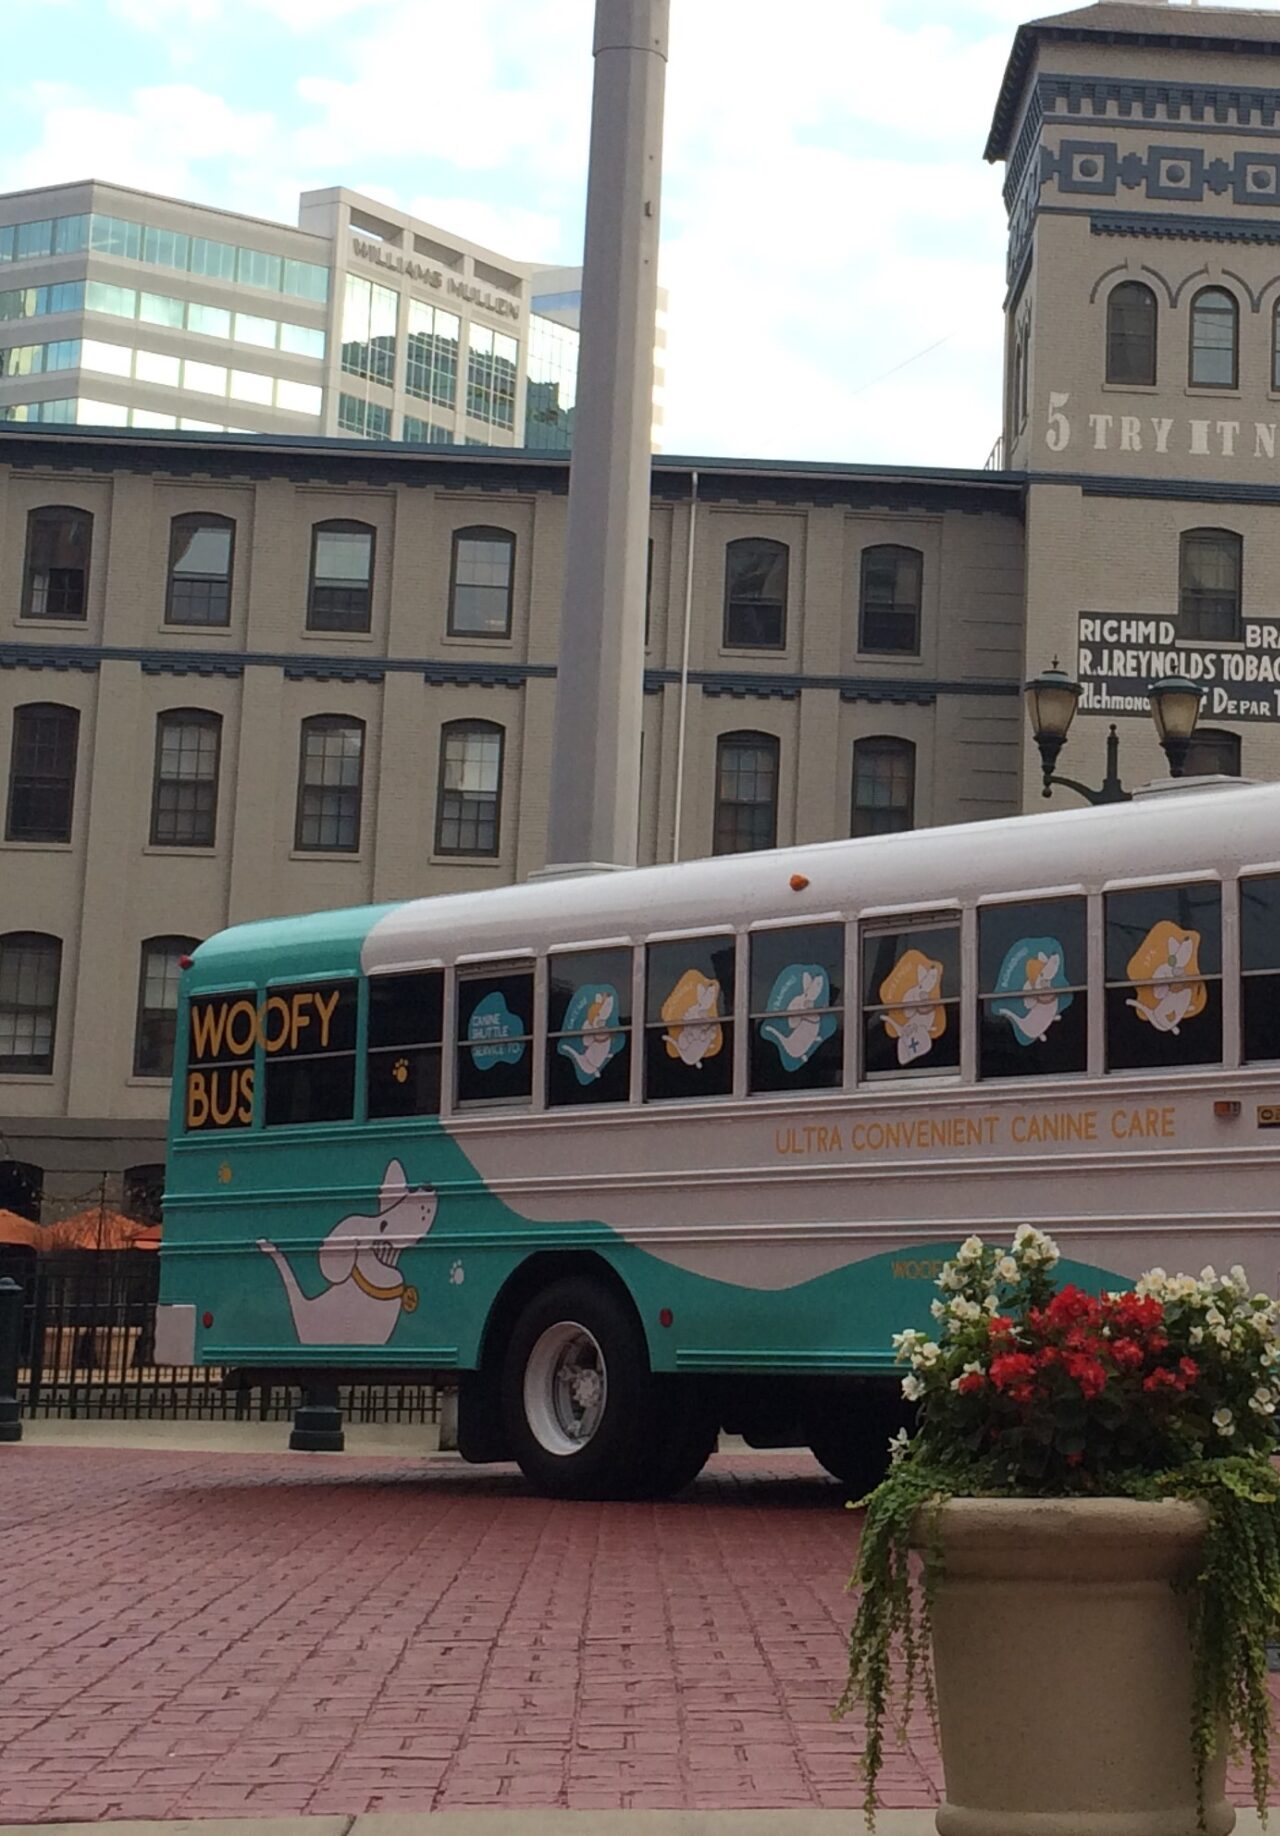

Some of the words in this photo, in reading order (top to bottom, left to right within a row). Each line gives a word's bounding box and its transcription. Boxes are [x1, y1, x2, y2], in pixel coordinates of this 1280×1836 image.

[352, 238, 443, 289] WILLIAMS
[447, 277, 520, 320] MULLEN
[1046, 391, 1070, 451] 5
[1089, 413, 1174, 454] TRY
[1188, 419, 1240, 456] IT
[1079, 618, 1176, 645] RICHMD
[191, 990, 340, 1059] WOOFY
[187, 1068, 256, 1127] BUS
[776, 1124, 842, 1154] ULTRA
[851, 1115, 998, 1151] CONVENIENT
[1011, 1111, 1097, 1143] CANINE
[1111, 1107, 1175, 1138] CARE
